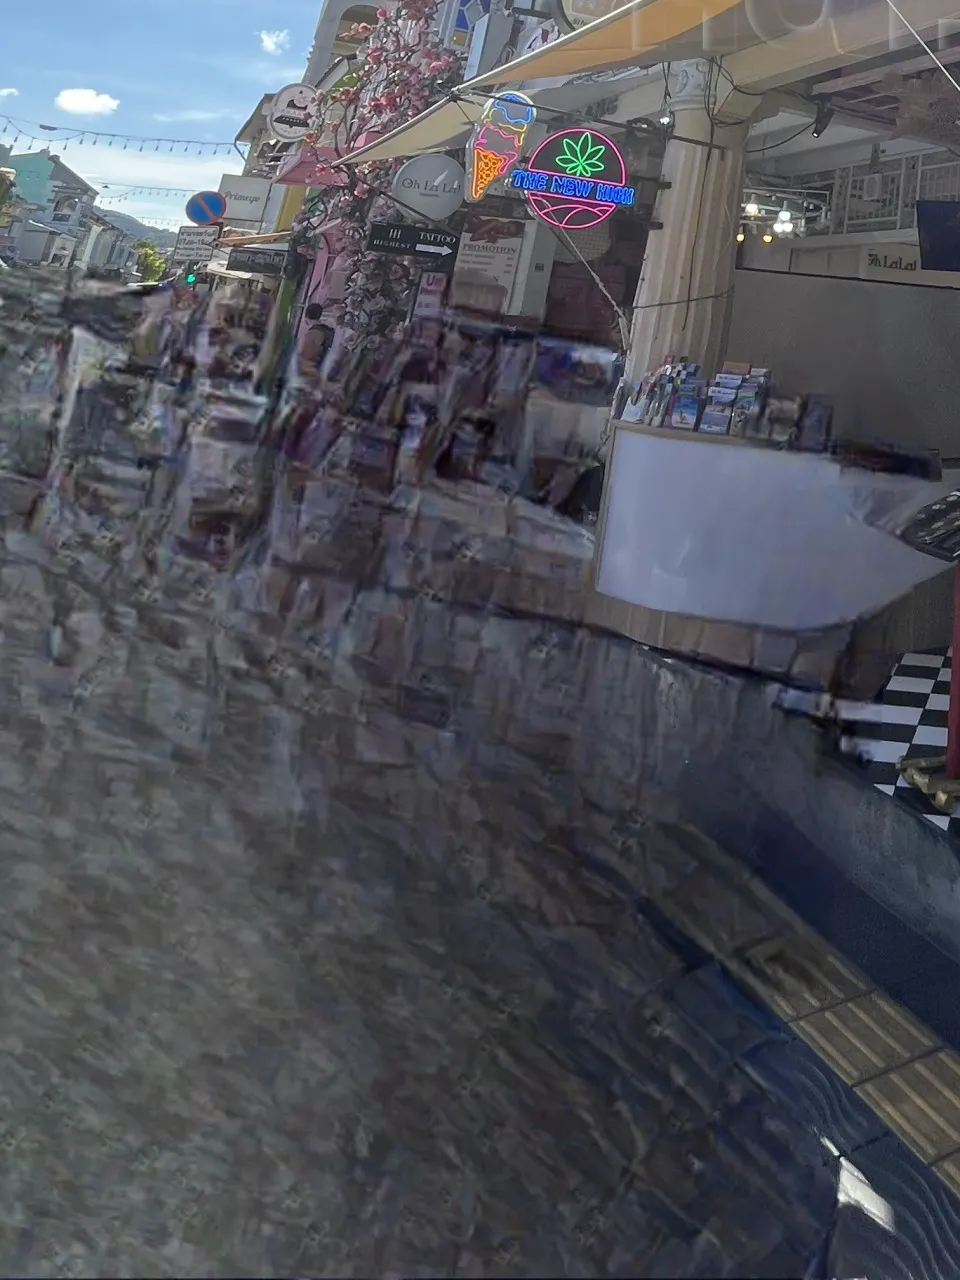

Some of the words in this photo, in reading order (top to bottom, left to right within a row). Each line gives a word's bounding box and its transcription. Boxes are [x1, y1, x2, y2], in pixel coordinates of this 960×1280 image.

[402, 177, 420, 189] Oh
[511, 170, 548, 191] THE
[550, 176, 594, 198] NEW
[595, 183, 635, 205] HIGH
[419, 231, 456, 244] TATTOO
